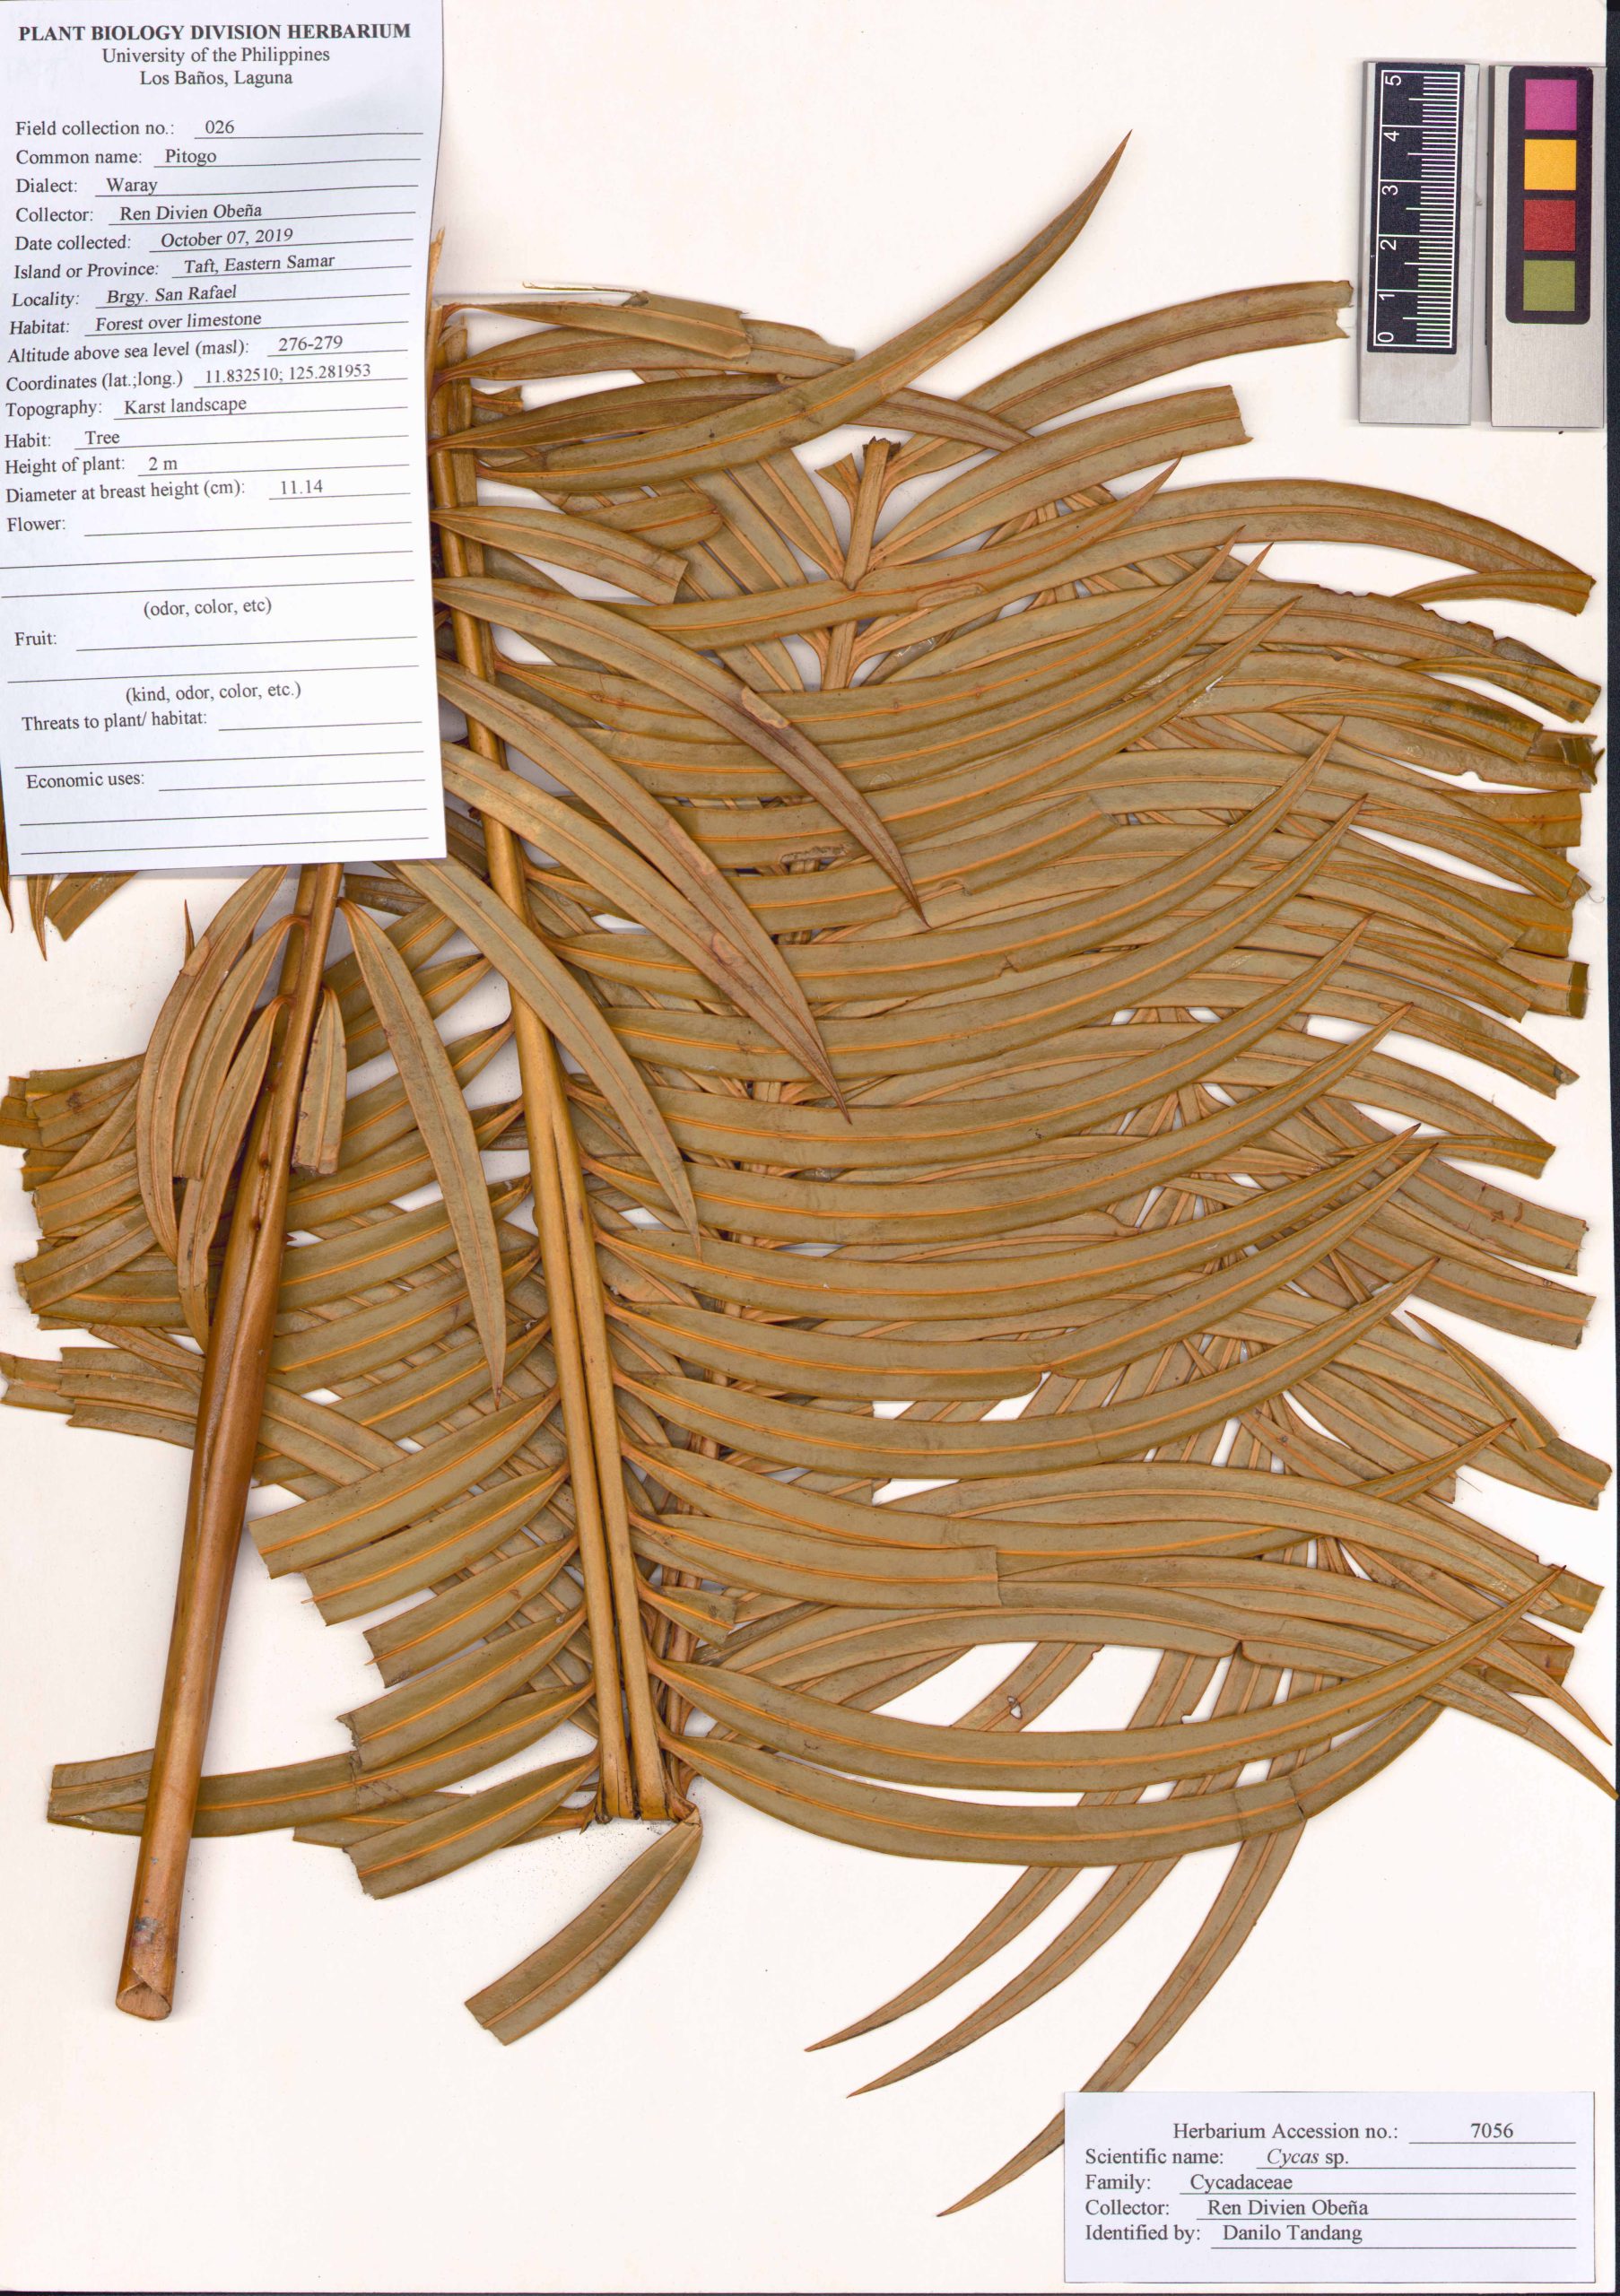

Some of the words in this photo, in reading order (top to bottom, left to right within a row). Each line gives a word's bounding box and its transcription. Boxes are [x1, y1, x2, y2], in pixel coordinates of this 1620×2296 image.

[18, 26, 86, 41] PLANT
[91, 24, 185, 41] BIOLOGY
[191, 24, 282, 40] DIVISION
[287, 23, 411, 39] HERBARIUM
[102, 47, 186, 66] University
[190, 47, 210, 63] of
[212, 47, 237, 63] the
[241, 46, 330, 66] Philippines
[140, 70, 170, 85] Los
[174, 70, 229, 87] Baños,
[234, 70, 293, 89] Laguna
[1384, 74, 1402, 87] 5
[15, 120, 57, 136] Field
[62, 119, 140, 135] collection
[145, 124, 174, 135] no.:
[205, 119, 235, 135] 026
[1383, 130, 1400, 143] 4
[15, 149, 90, 165] Common
[94, 152, 143, 165] name:
[165, 148, 217, 168] Pitogo
[16, 178, 77, 193] Dialect:
[106, 178, 159, 196] Waray
[1381, 185, 1398, 196] 3
[15, 206, 93, 222] Collector:
[120, 206, 151, 222] Ren
[156, 204, 208, 221] Divien
[213, 204, 263, 219] Obeña
[14, 236, 53, 251] Date
[57, 233, 131, 251] collected:
[161, 231, 223, 248] October
[226, 230, 249, 249] 07,
[255, 228, 293, 243] 2019
[1380, 239, 1397, 251] 2
[14, 264, 61, 280] Island
[65, 267, 83, 278] or
[87, 261, 159, 277] Province:
[184, 257, 219, 275] Taft,
[223, 257, 281, 272] Eastern
[286, 255, 335, 269] Samar
[12, 291, 80, 313] Locality:
[106, 290, 148, 308] Brgy.
[154, 287, 183, 302] San
[187, 283, 237, 300] Rafael
[1378, 293, 1396, 301] 1
[9, 318, 70, 335] Habitat:
[95, 317, 144, 332] Forest
[148, 317, 183, 330] over
[187, 312, 262, 328] limestone
[1377, 331, 1395, 344] 0
[6, 346, 70, 363] Altitude
[74, 345, 120, 361] above
[124, 347, 149, 359] sea
[152, 341, 189, 357] level
[195, 340, 250, 359] (masl):
[278, 335, 344, 352] 276-279
[5, 374, 98, 392] Coordinates
[101, 370, 183, 391] (lat.;long.)
[206, 368, 283, 384] 11.832510;
[291, 363, 373, 381] 125.281953
[5, 399, 104, 421] Topography:
[124, 400, 166, 414] Karst
[170, 396, 247, 416] landscape
[4, 432, 51, 448] Habit:
[84, 430, 120, 445] Tree
[4, 457, 57, 477] Height
[61, 456, 80, 473] of
[83, 456, 126, 475] plant:
[149, 457, 158, 471] 2
[163, 459, 178, 471] m
[6, 487, 77, 503] Diameter
[82, 487, 95, 500] at
[100, 483, 146, 500] breast
[151, 481, 199, 500] height
[204, 480, 246, 498] (cm):
[282, 479, 323, 495] 11.14
[6, 517, 66, 532] Flower:
[144, 600, 189, 619] (odor,
[195, 598, 238, 614] color,
[243, 597, 272, 613] etc)
[14, 631, 57, 647] Fruit:
[126, 686, 170, 705] (kind,
[175, 684, 214, 704] odor,
[219, 683, 262, 702] color,
[267, 683, 301, 700] etc.)
[21, 716, 80, 731] Threats
[83, 716, 100, 729] to
[104, 711, 147, 732] plant/
[151, 709, 209, 726] habitat:
[26, 771, 104, 789] Economic
[108, 773, 145, 787] uses:
[1173, 2122, 1266, 2139] Herbarium
[1271, 2122, 1359, 2139] Accession
[1365, 2126, 1398, 2140] no.:
[1470, 2122, 1514, 2139] 7056
[1085, 2147, 1167, 2164] Scientific
[1171, 2149, 1224, 2165] name:
[1267, 2148, 1320, 2170] Cycas
[1325, 2152, 1349, 2169] sp.
[1085, 2173, 1151, 2195] Family:
[1190, 2173, 1293, 2196] Cycadaceae
[1084, 2199, 1170, 2215] Collector:
[1207, 2199, 1242, 2216] Ren
[1248, 2198, 1306, 2215] Divien
[1311, 2198, 1369, 2216] Obeña
[1084, 2223, 1169, 2241] Identified
[1175, 2223, 1201, 2246] by:
[1223, 2223, 1281, 2240] Danilo
[1286, 2223, 1363, 2245] Tandang
